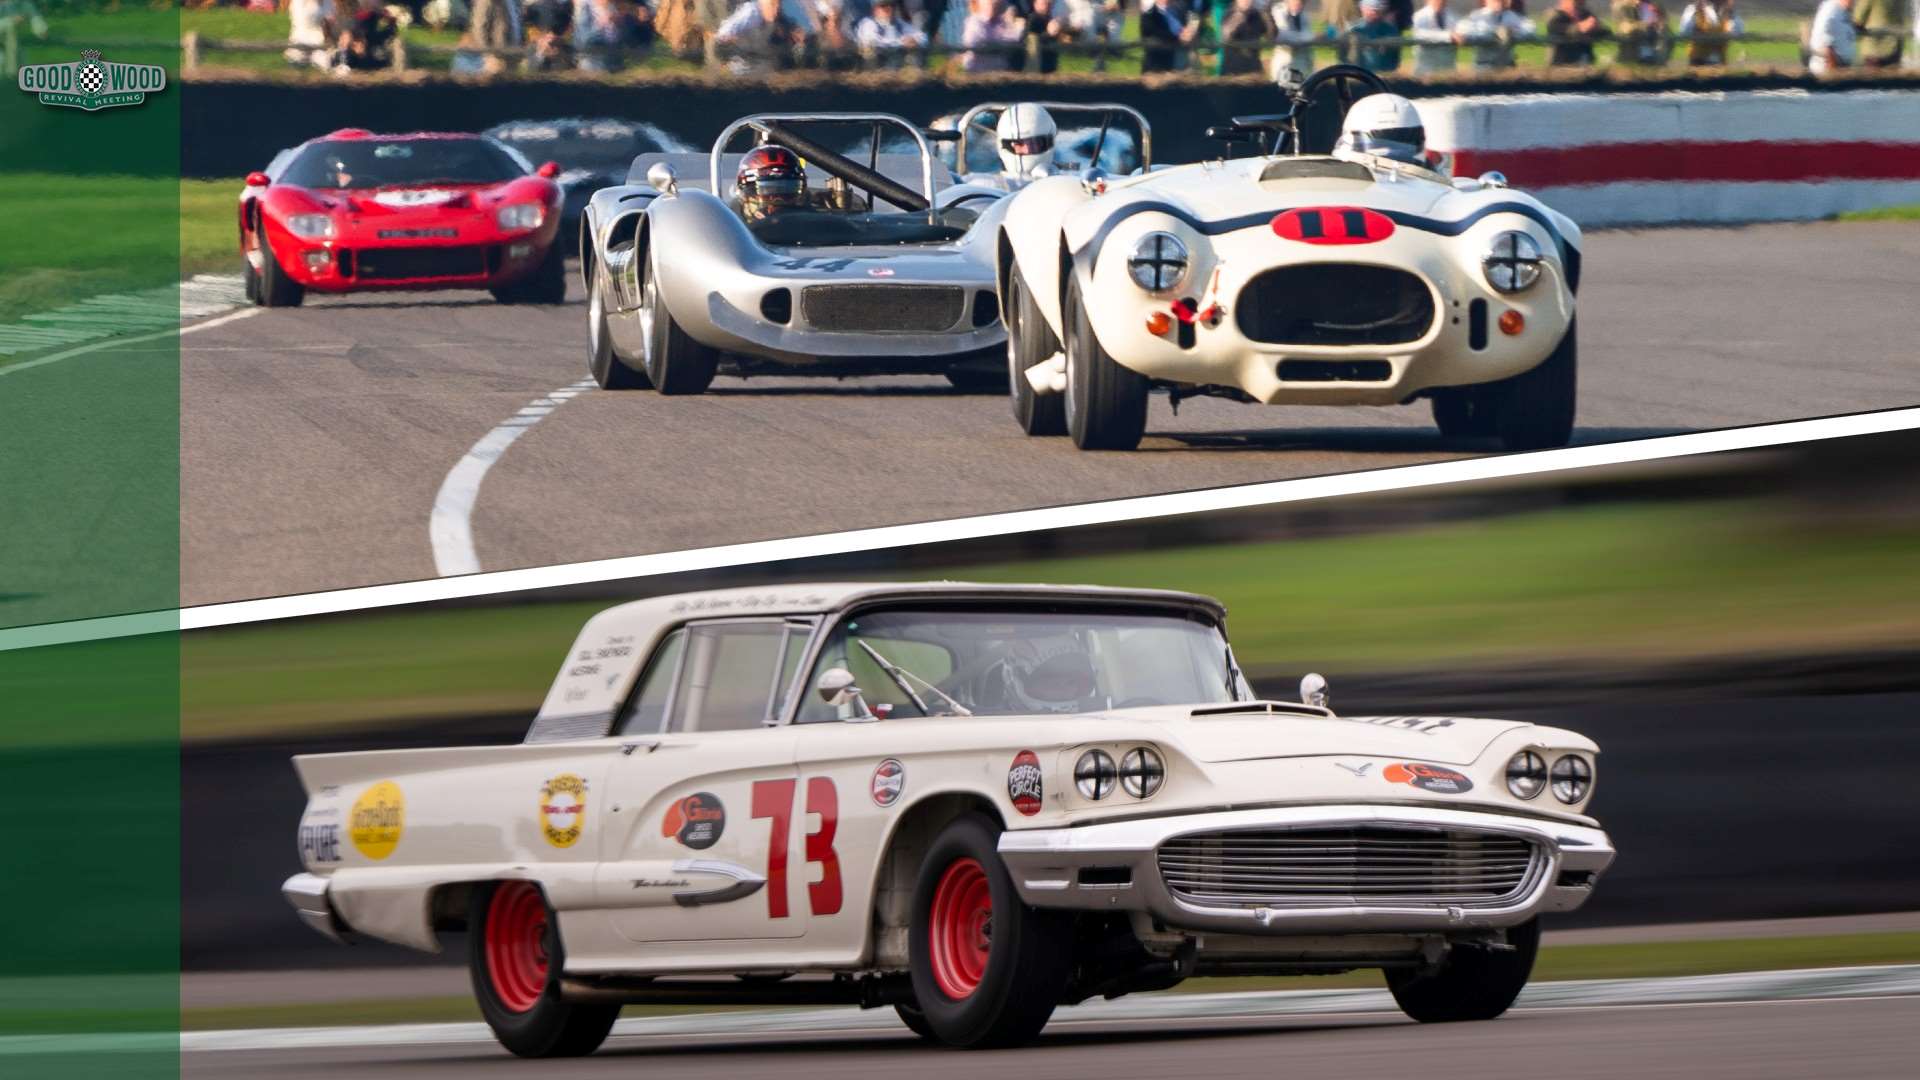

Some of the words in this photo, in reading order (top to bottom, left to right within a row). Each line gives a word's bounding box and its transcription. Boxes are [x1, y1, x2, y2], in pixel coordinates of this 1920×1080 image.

[1297, 210, 1369, 238] 11
[772, 257, 858, 273] 44
[1009, 764, 1041, 785] PERFECT
[1011, 780, 1041, 799] CIRCLE
[751, 776, 844, 919] 73
